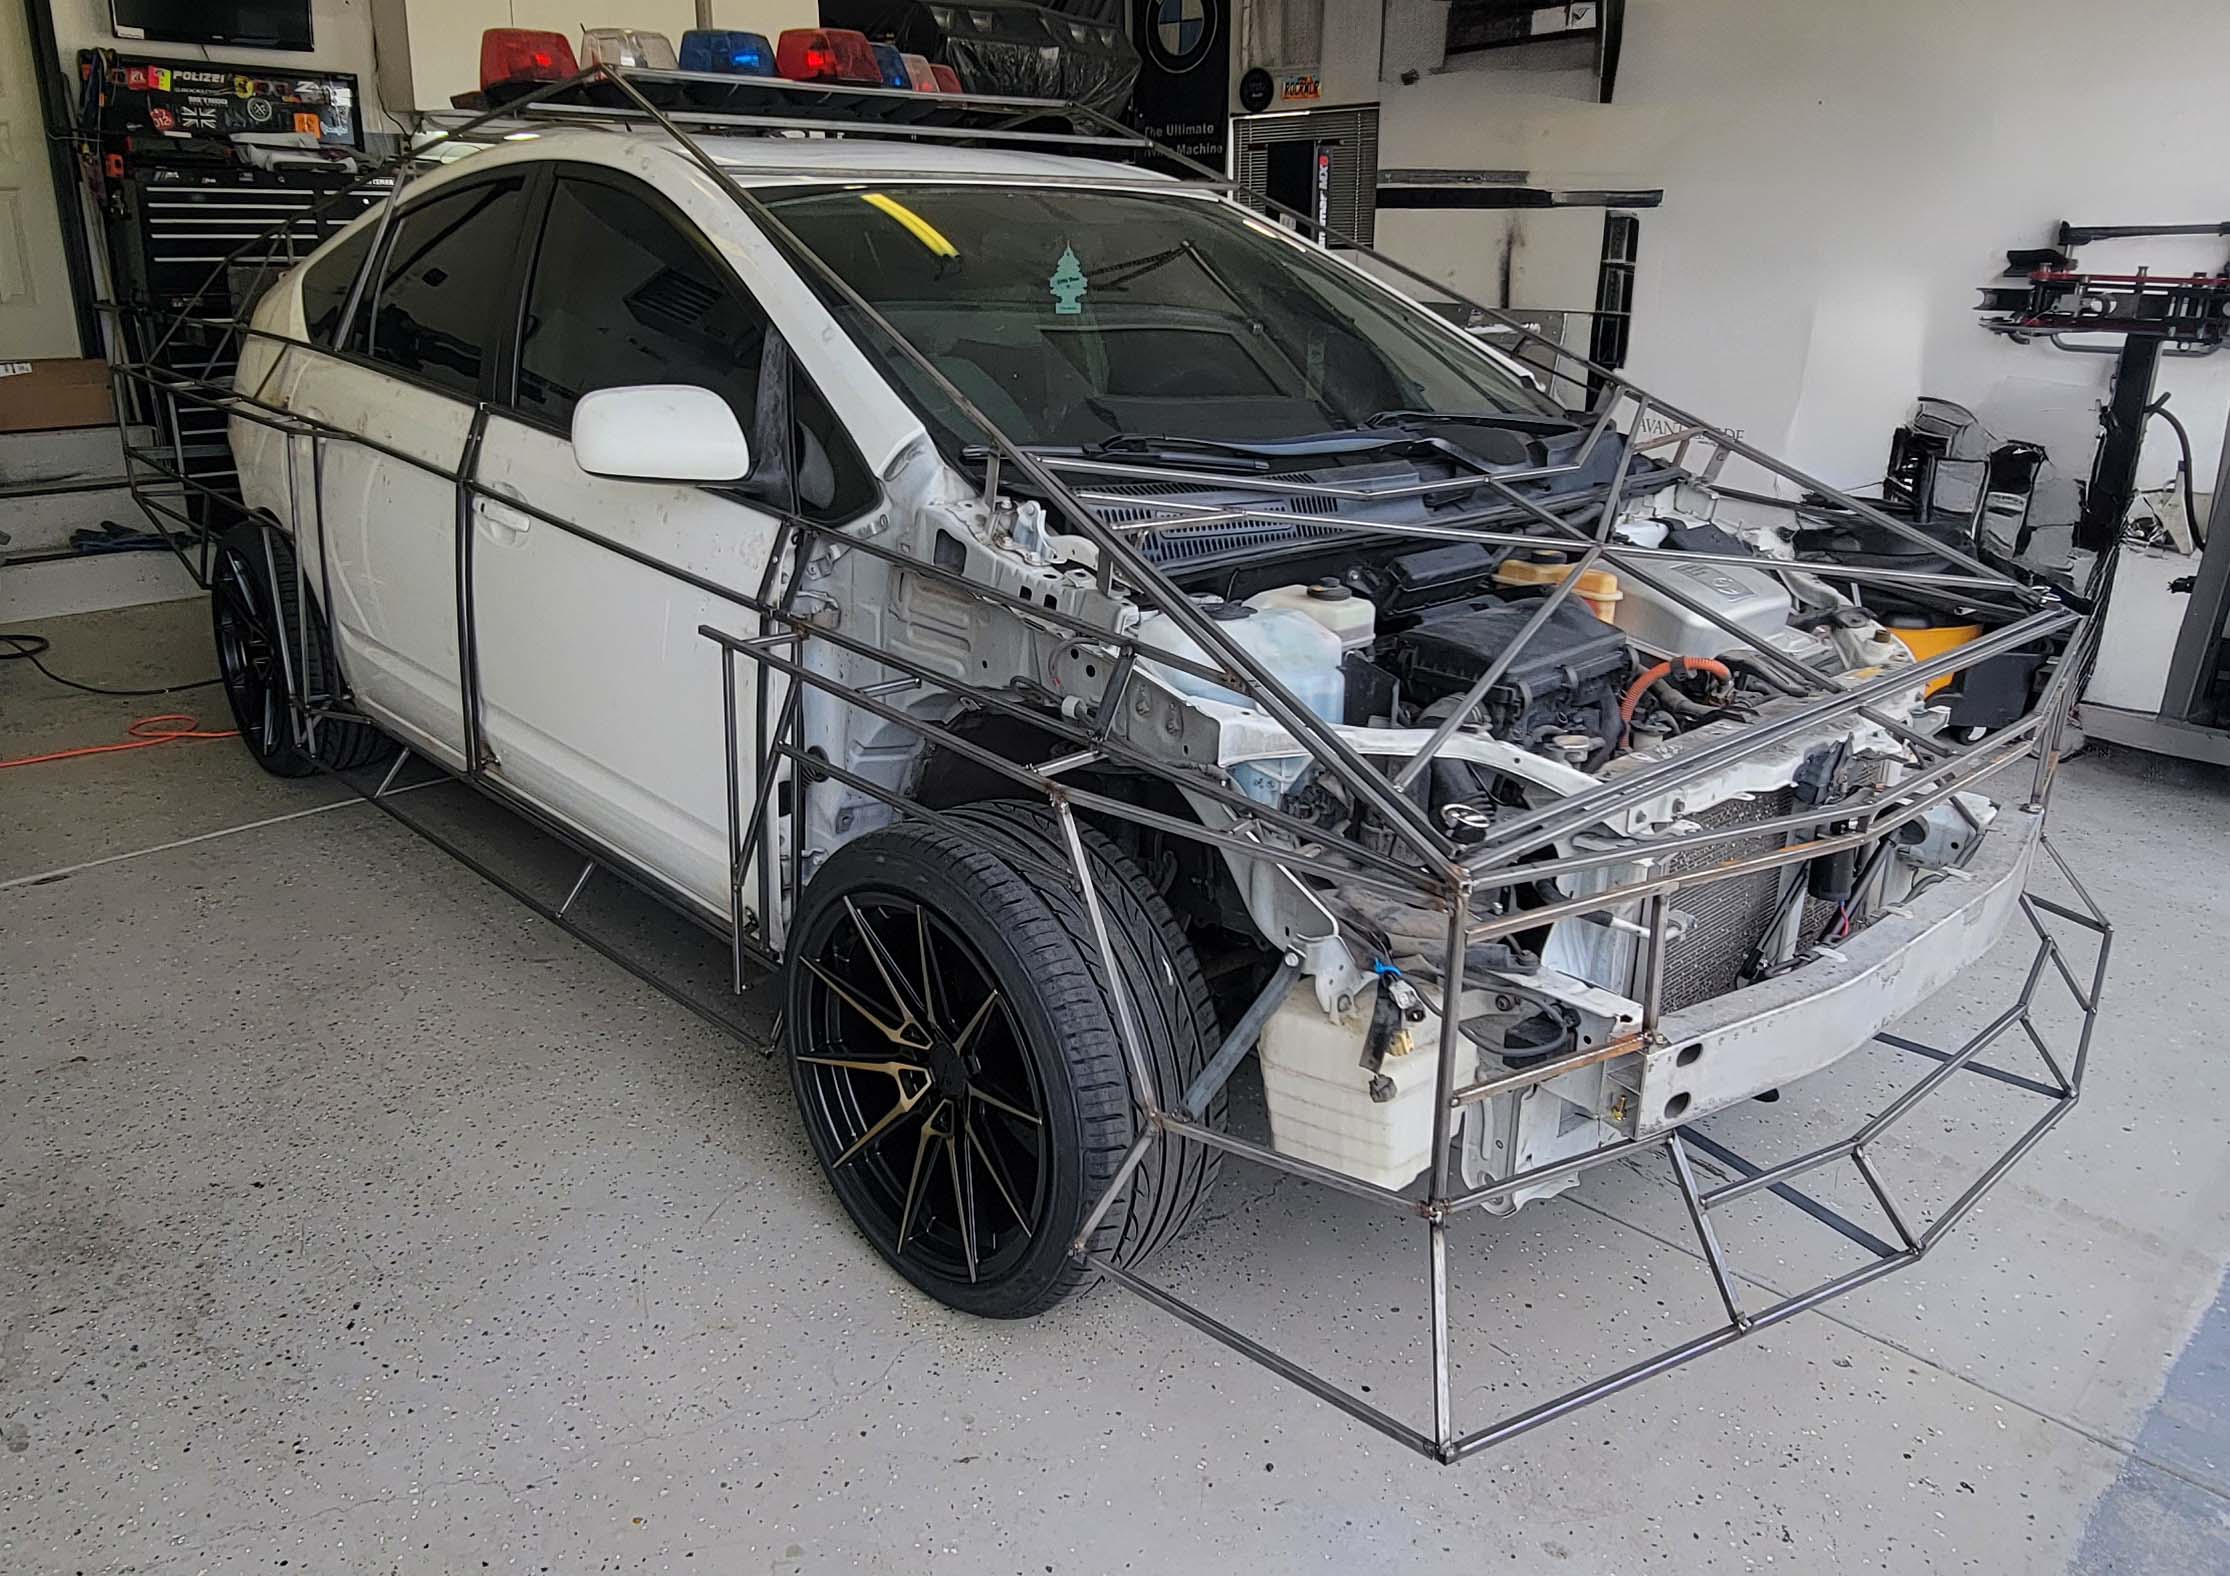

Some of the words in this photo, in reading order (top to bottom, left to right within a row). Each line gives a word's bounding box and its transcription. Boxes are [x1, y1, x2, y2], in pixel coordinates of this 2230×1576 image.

[173, 70, 225, 83] POLIZEI
[1166, 123, 1214, 136] Ultimate
[1176, 142, 1223, 155] Machine
